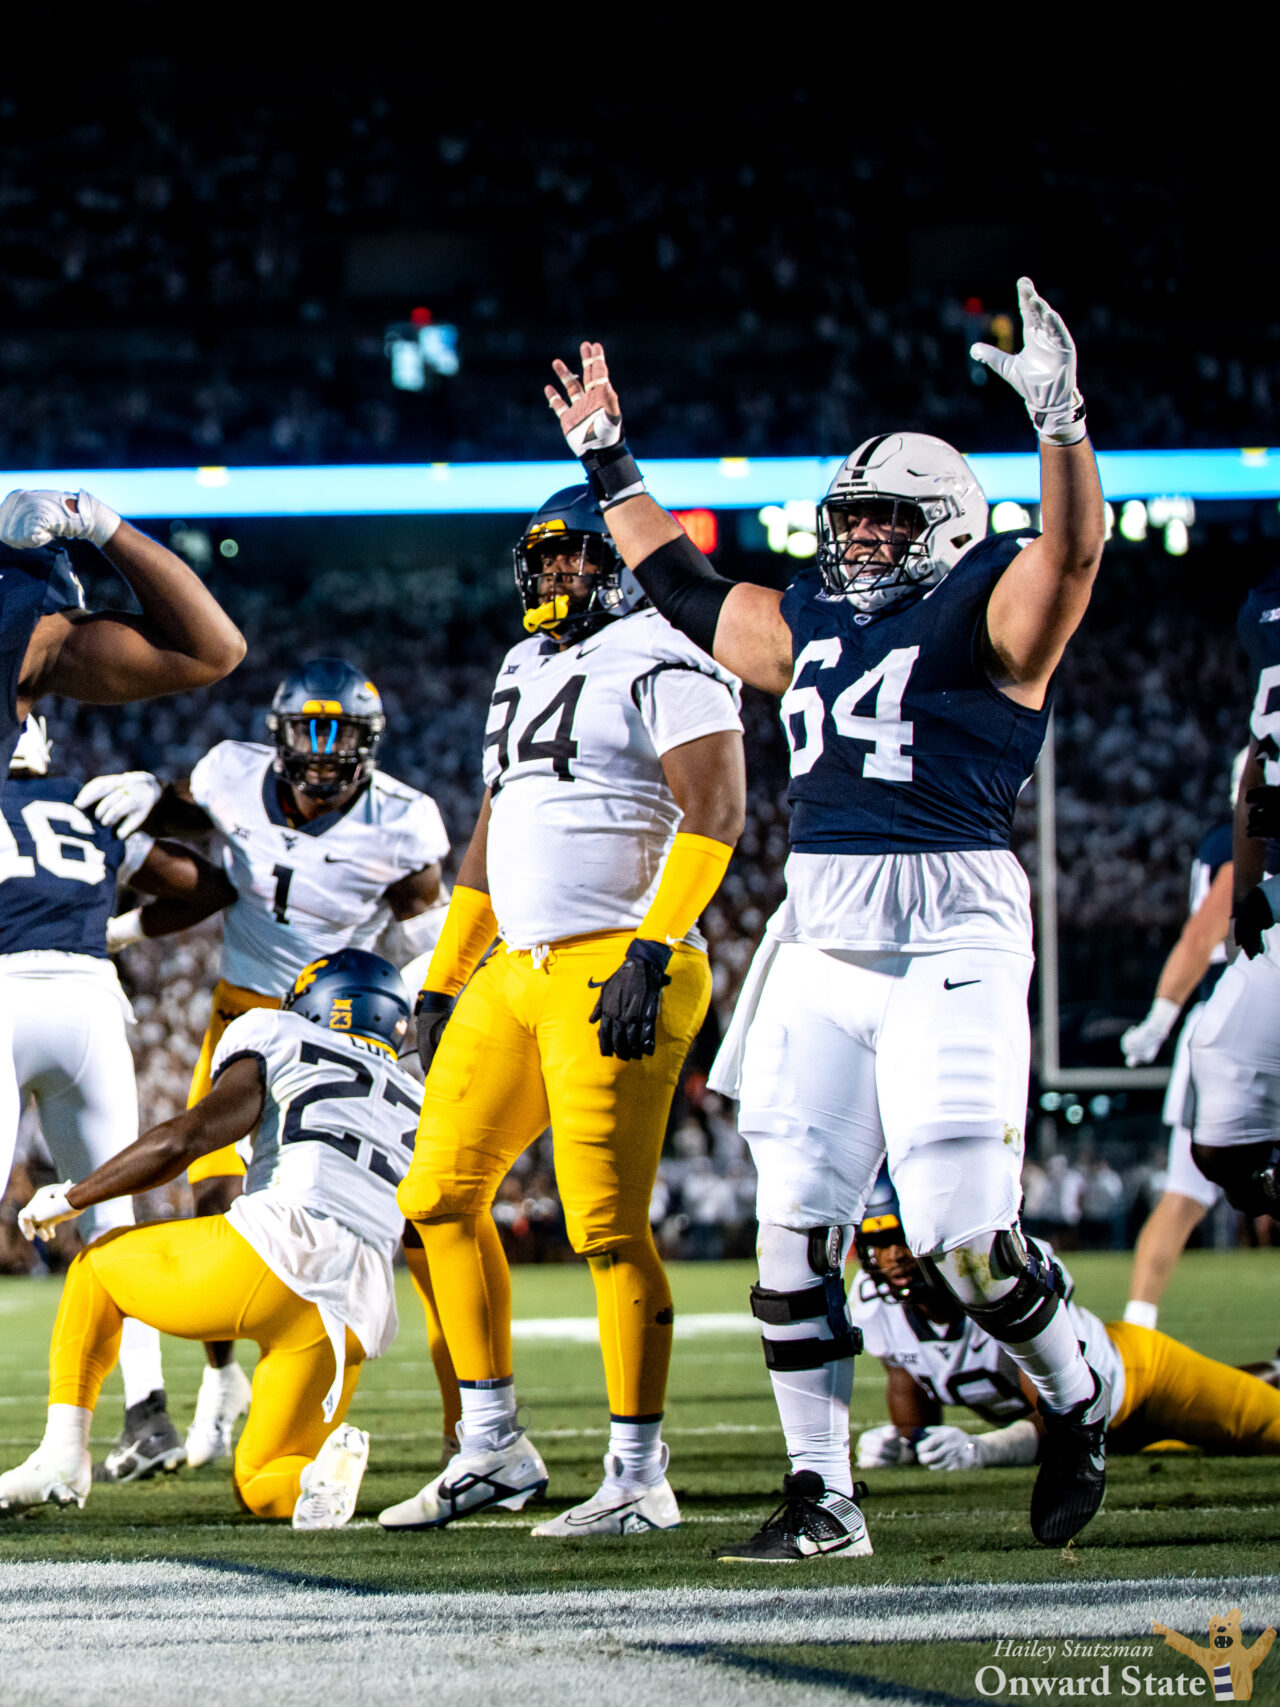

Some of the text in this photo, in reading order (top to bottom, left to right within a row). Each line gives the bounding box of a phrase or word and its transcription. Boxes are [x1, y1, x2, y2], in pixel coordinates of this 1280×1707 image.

[780, 636, 920, 782] 64
[272, 864, 294, 925] 1
[329, 1010, 352, 1029] 23
